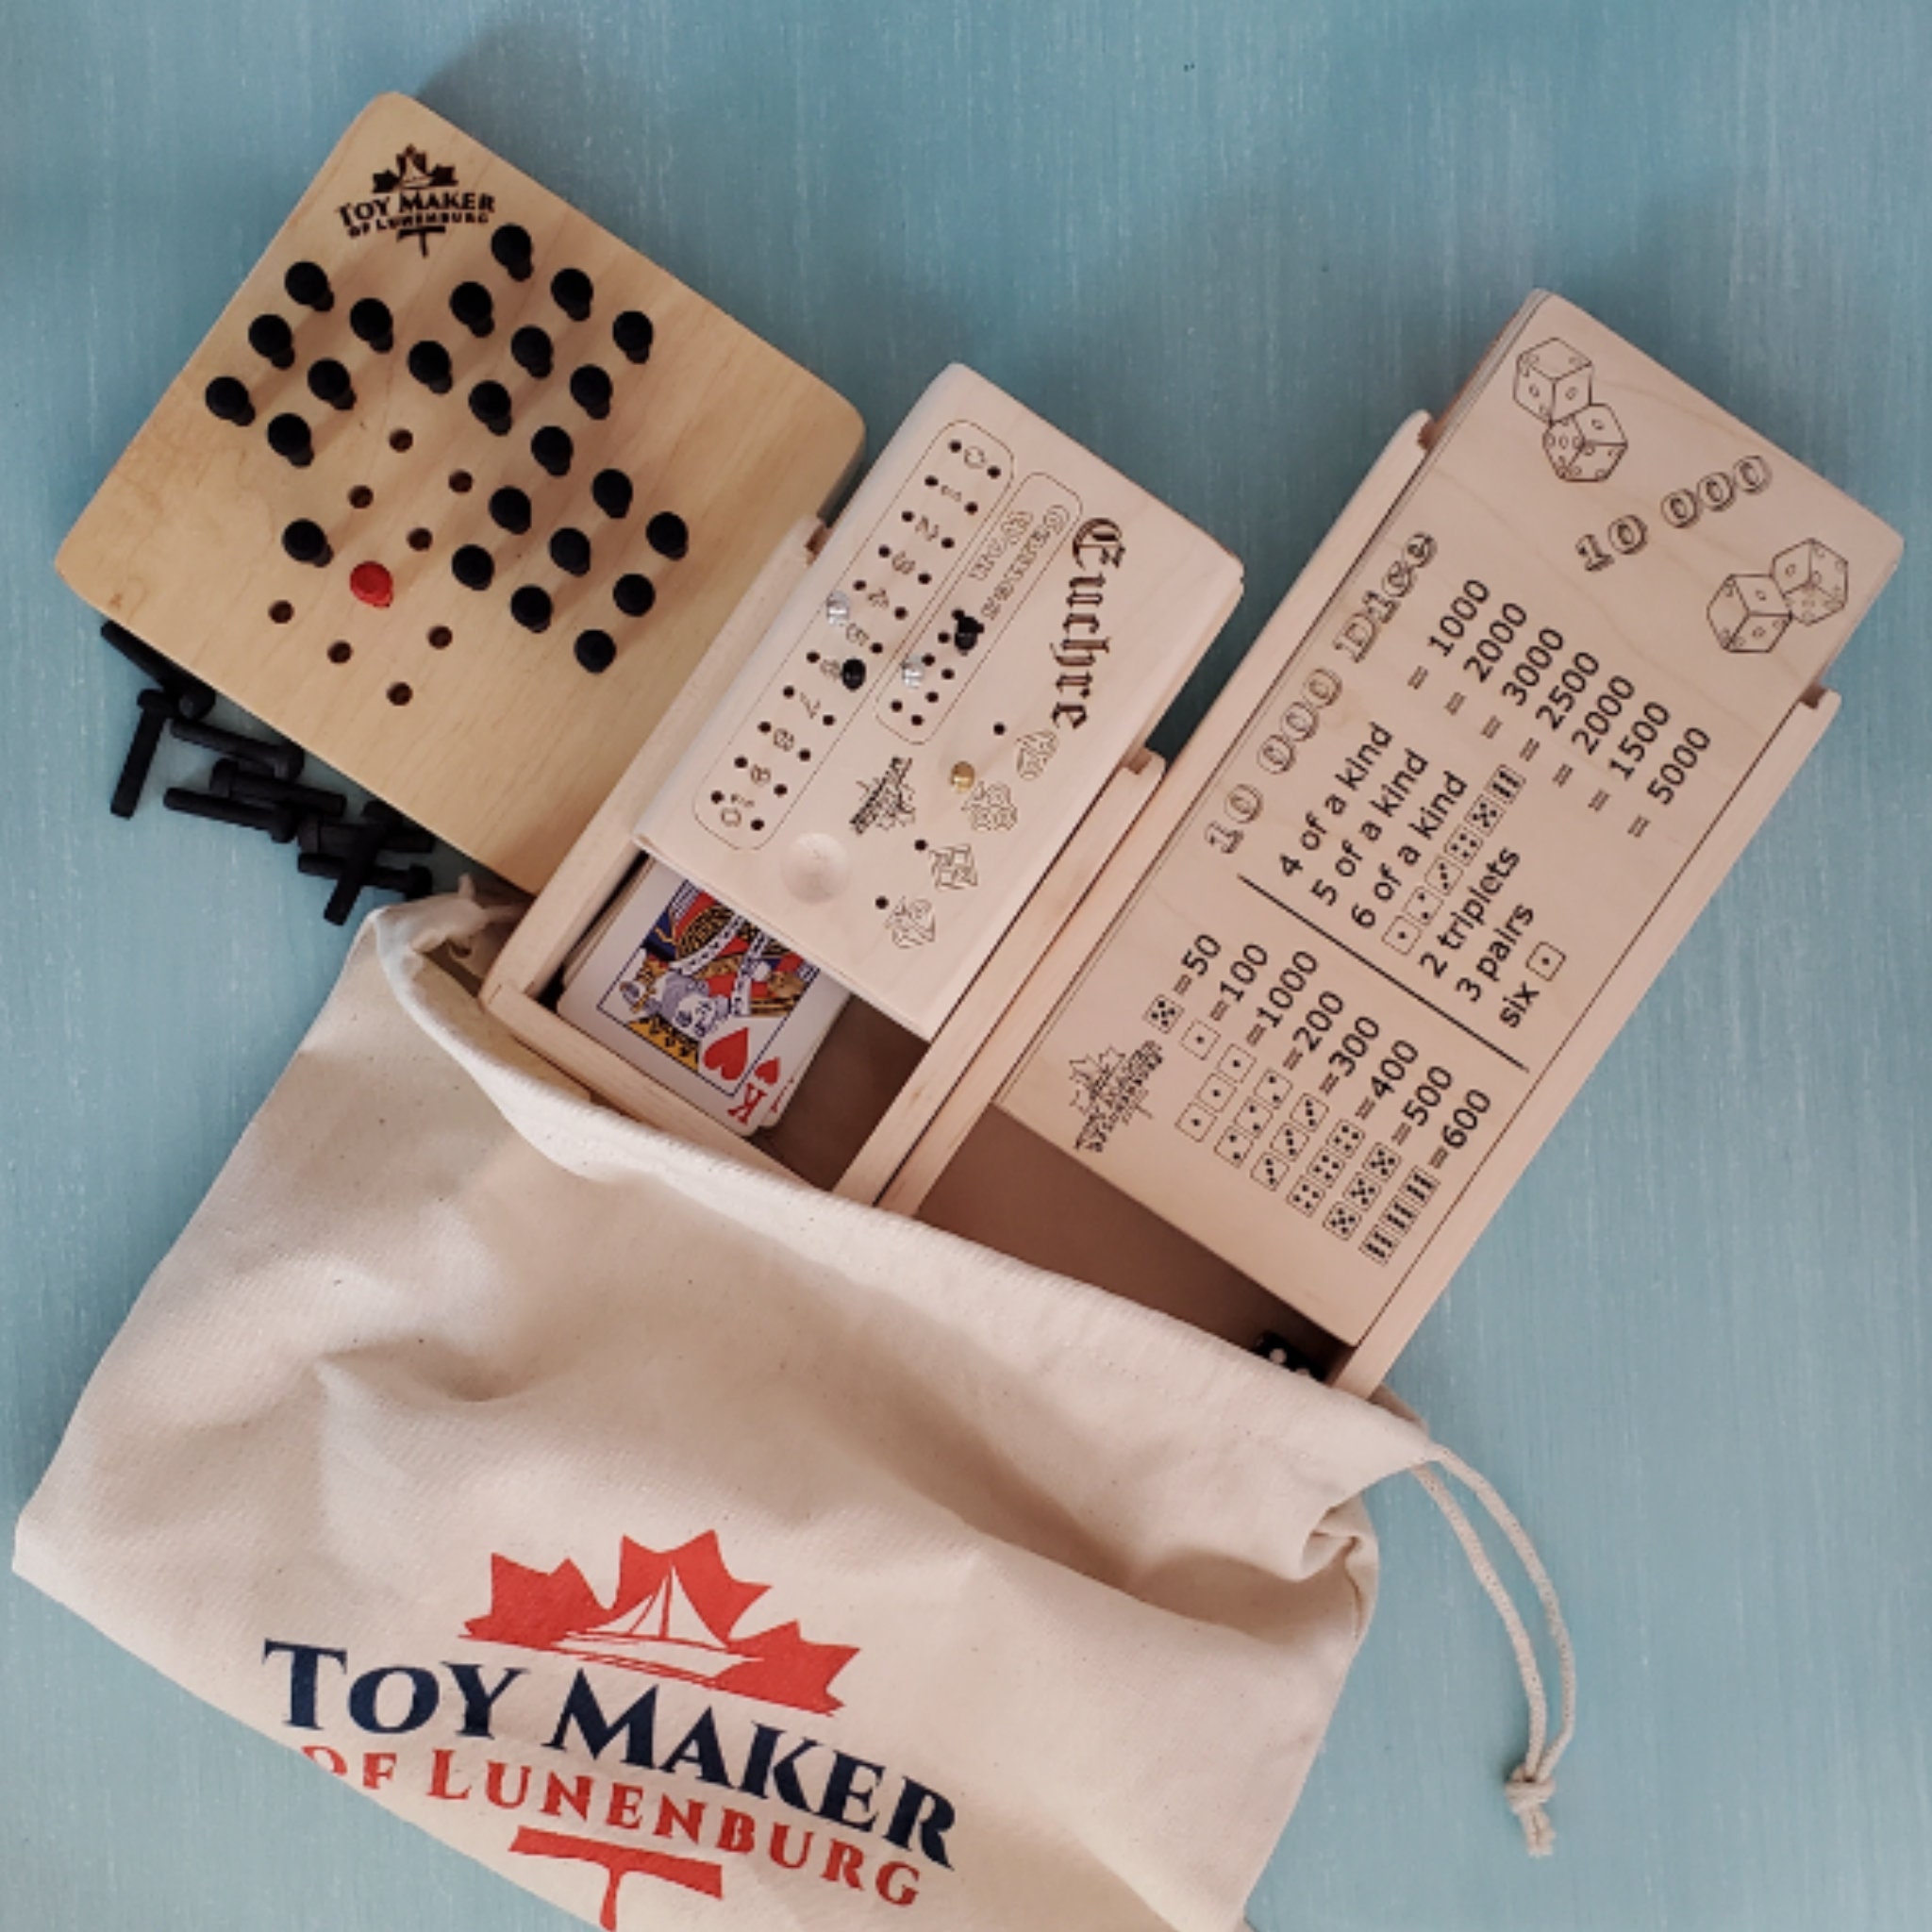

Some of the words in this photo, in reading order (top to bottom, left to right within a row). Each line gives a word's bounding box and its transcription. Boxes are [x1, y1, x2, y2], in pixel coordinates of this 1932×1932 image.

[335, 196, 390, 226] TOY
[399, 192, 495, 213] MAKER
[1575, 513, 1648, 573] 10
[1660, 455, 1773, 529] 000
[1049, 518, 1126, 730] Euchre
[1205, 784, 1263, 855] 10
[1257, 668, 1343, 774] 000
[1333, 531, 1438, 663] Dice
[1501, 627, 1564, 707] 3000
[1535, 652, 1600, 730] 2500
[1279, 855, 1303, 877] 4
[1299, 812, 1327, 850] of
[1325, 794, 1346, 815] a
[1336, 722, 1393, 792] kind
[1426, 578, 1491, 658] 1000
[1309, 882, 1338, 907] 5
[1335, 841, 1364, 878] of
[1361, 821, 1383, 842] a
[1372, 748, 1429, 819] kind
[1463, 602, 1528, 683] 2000
[1398, 845, 1421, 867] a
[1409, 771, 1469, 842] kind
[1418, 954, 1448, 978] 2
[1438, 848, 1521, 952] triplets
[1572, 675, 1635, 756] 2000
[1456, 978, 1482, 1002] 3
[1477, 903, 1535, 981] pairs
[1608, 701, 1672, 781] 1500
[1351, 905, 1375, 928] 6
[1373, 864, 1400, 902] of
[1498, 982, 1541, 1028] six
[1647, 726, 1711, 806] 5000
[727, 1082, 768, 1125] K
[262, 1638, 530, 1740] TOY
[541, 1668, 958, 1871] MAKER
[427, 1747, 921, 1908] LUNENBURG
